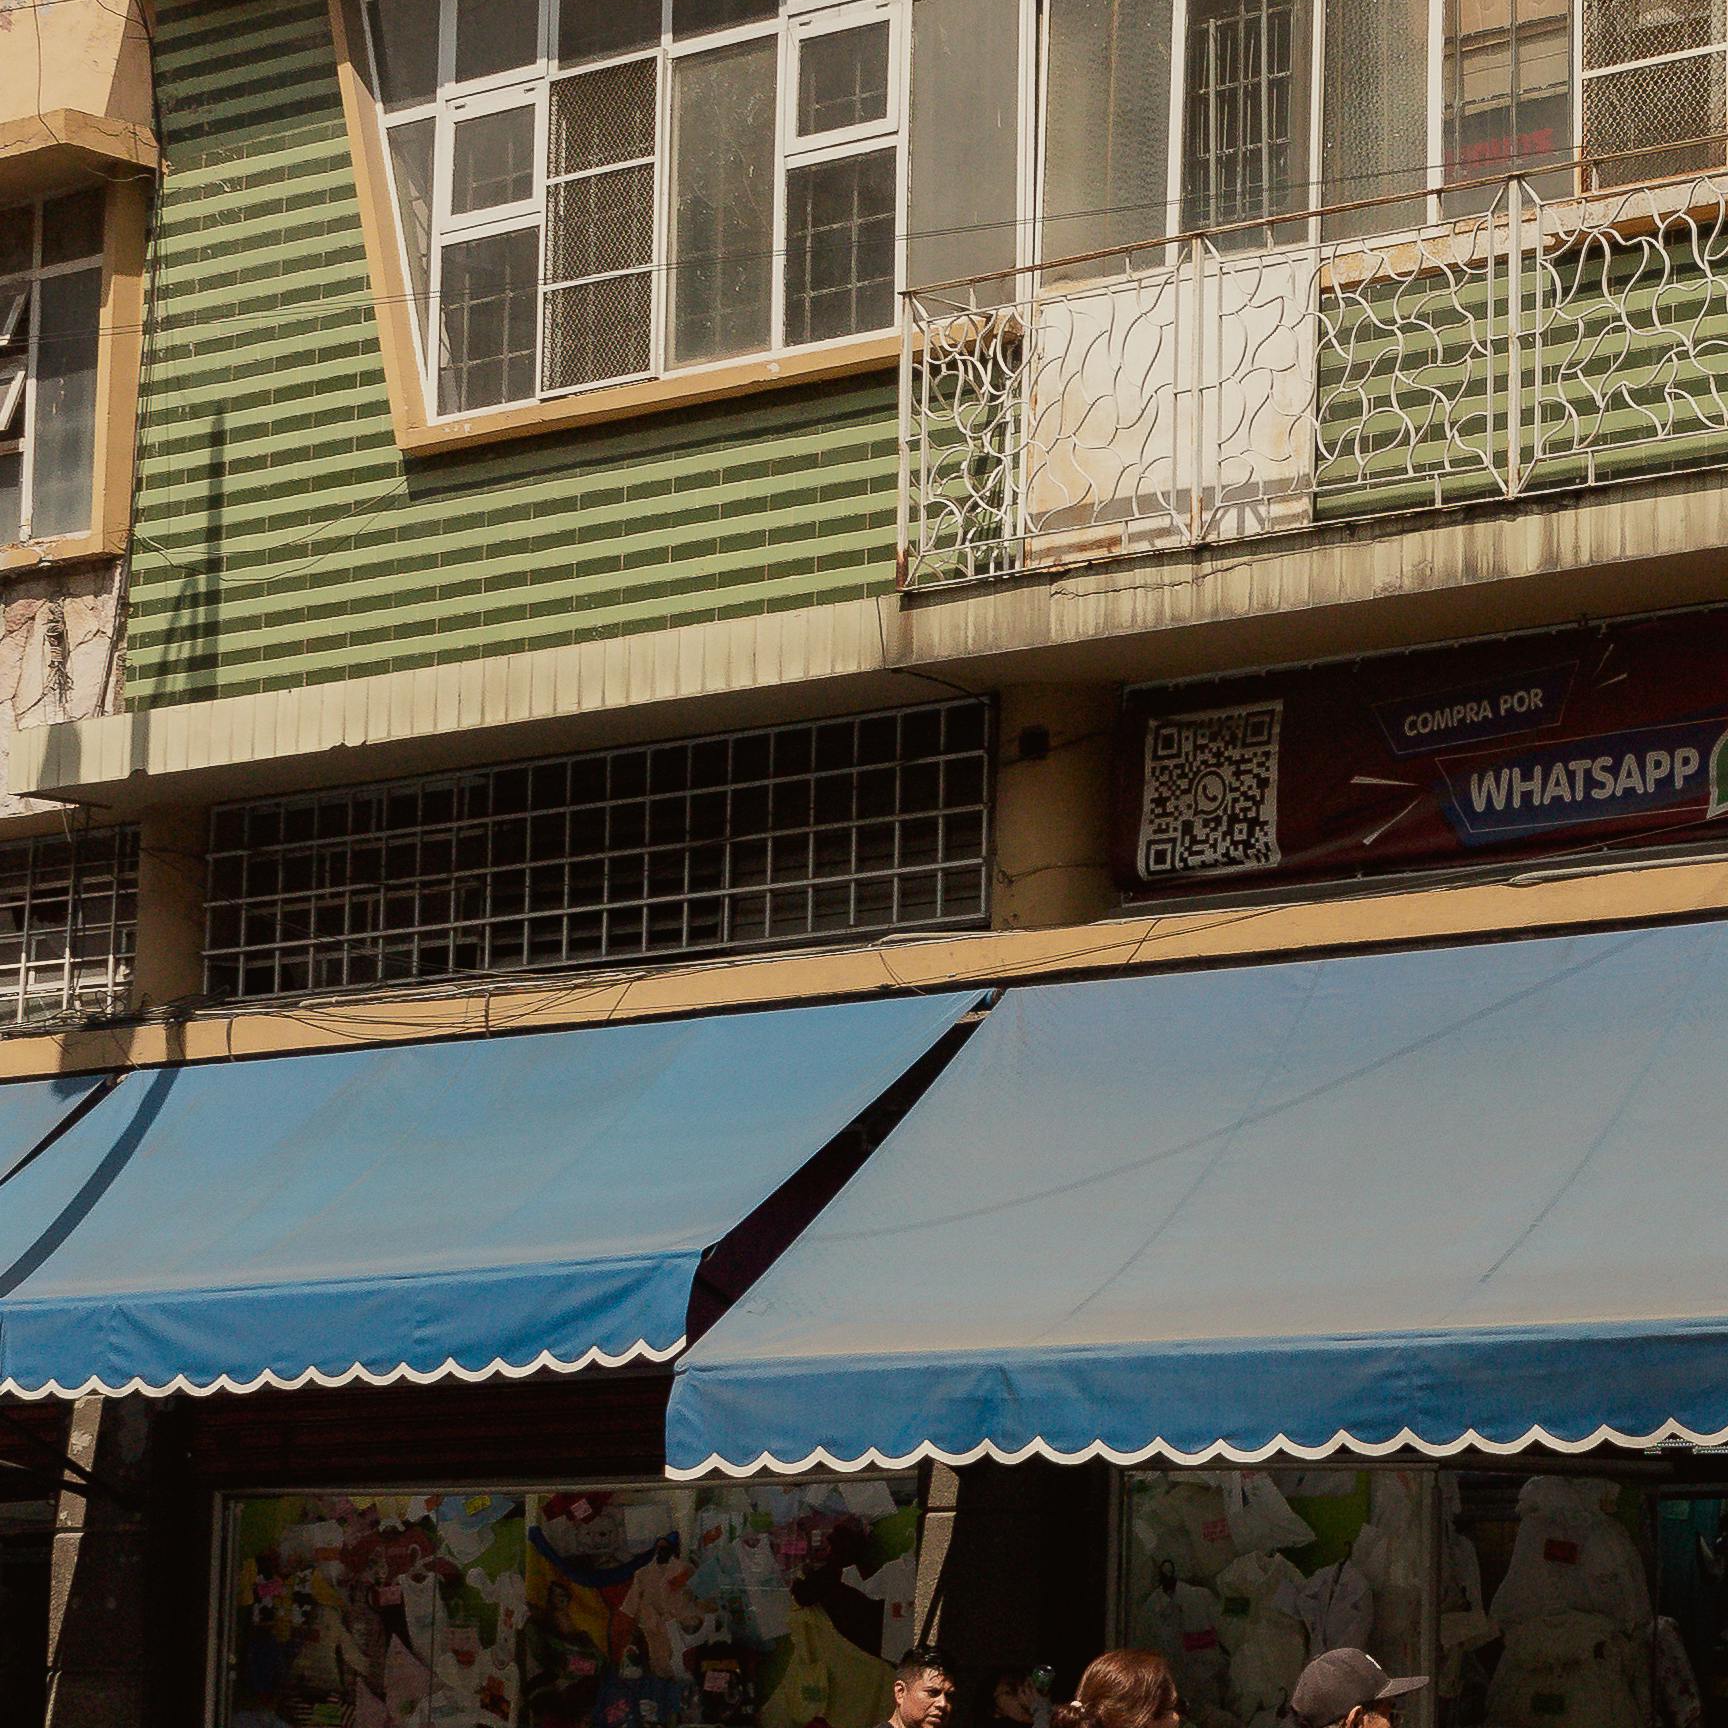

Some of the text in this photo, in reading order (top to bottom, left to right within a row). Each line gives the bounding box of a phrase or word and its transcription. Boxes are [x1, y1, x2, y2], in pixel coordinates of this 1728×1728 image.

[1404, 688, 1544, 737] COMPRA POR
[1470, 747, 1700, 814] WHATSAPP
